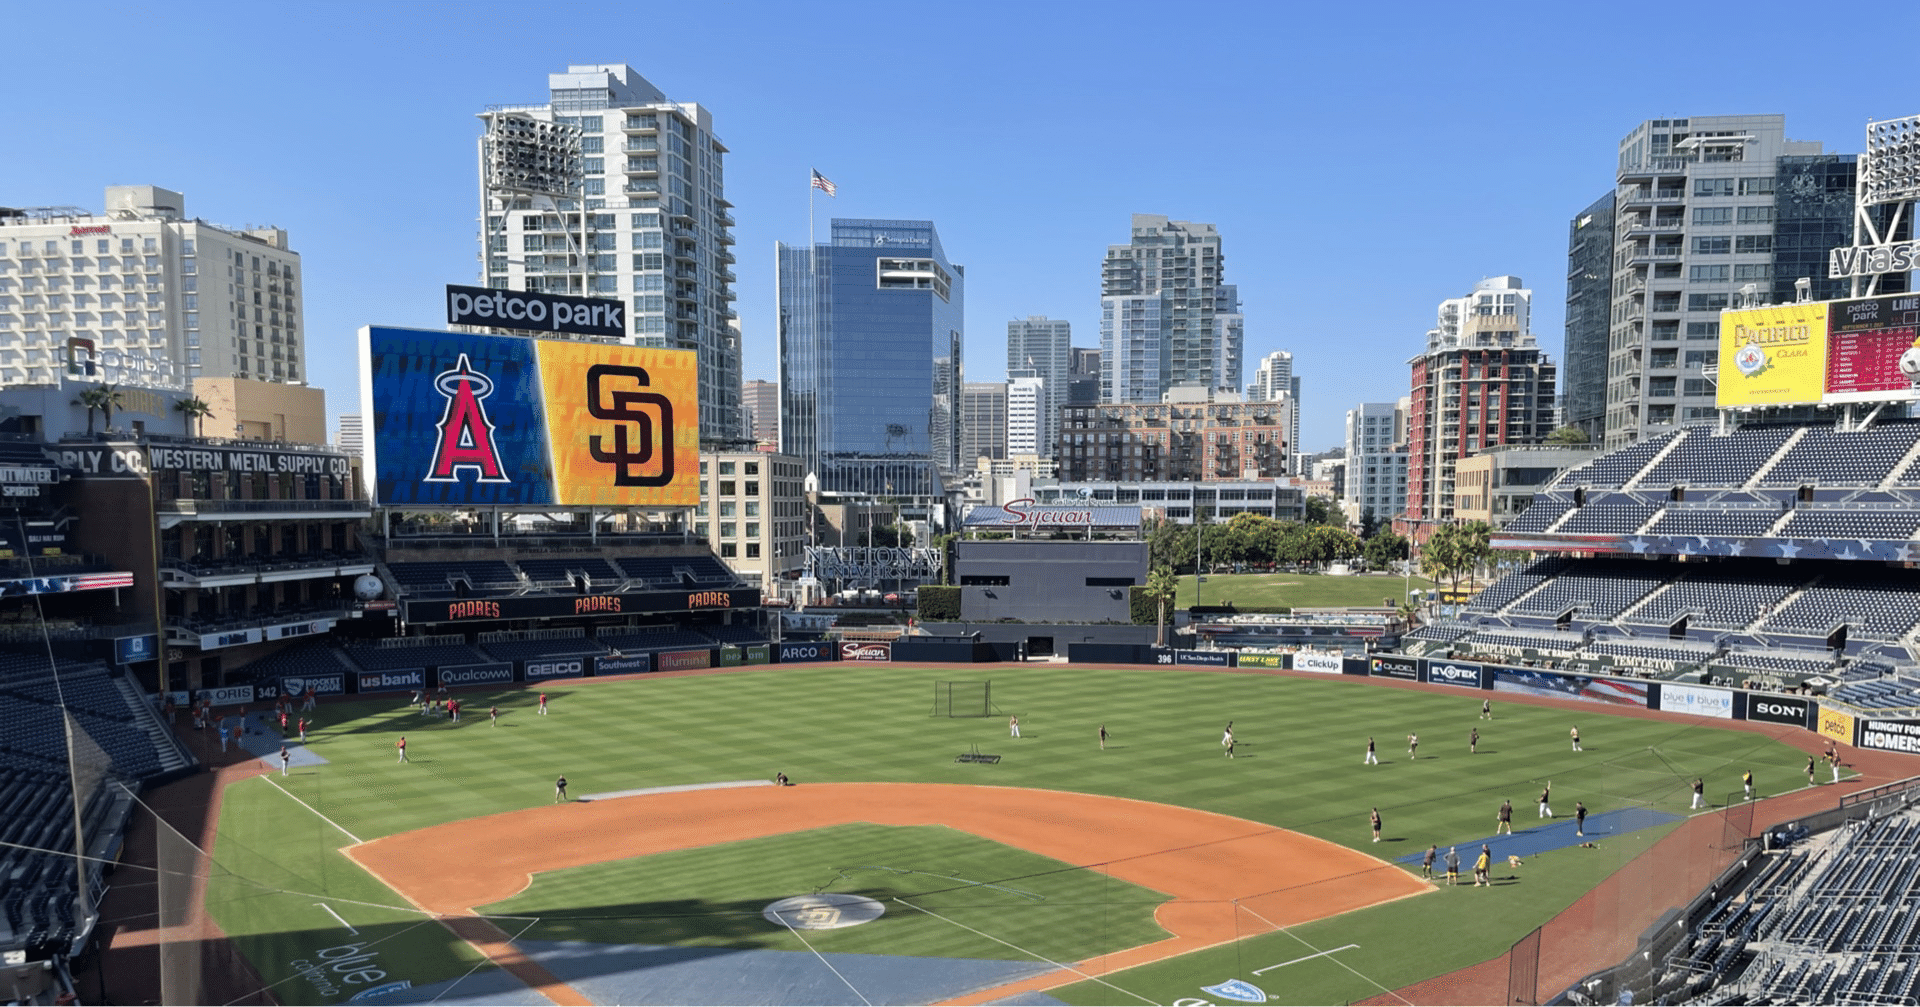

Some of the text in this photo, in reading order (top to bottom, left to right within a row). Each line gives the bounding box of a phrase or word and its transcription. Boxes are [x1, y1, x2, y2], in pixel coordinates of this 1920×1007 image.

[450, 291, 623, 330] petco park
[1847, 303, 1879, 315] petco
[1892, 298, 1919, 311] LINE
[1852, 311, 1878, 323] park
[111, 450, 148, 473] CO.
[150, 448, 350, 474] WESTERN METAL SUPPLY CO.
[3, 486, 40, 497] SPIRITS
[1052, 498, 1117, 507] Gallagher Square
[1001, 498, 1096, 531] Sycuan
[815, 564, 941, 579] UNIVERSITY
[575, 596, 621, 614] PADRES
[688, 591, 730, 609] PADRES
[449, 600, 501, 620] PADRES
[782, 647, 818, 659] ARCO
[842, 643, 885, 660] Sycuan
[1471, 643, 1523, 657] TEMPLETON
[598, 660, 641, 670] Southwest
[662, 657, 707, 668] illumina
[1157, 654, 1172, 664] 396
[1307, 659, 1339, 670] ClickUp
[1612, 654, 1675, 672] TEMPLETON
[441, 669, 510, 683] Qualcomm
[527, 662, 582, 676] GEICO
[1431, 665, 1478, 679] EVOTEK
[216, 687, 251, 700] ORIS
[258, 687, 277, 698] 342
[1663, 692, 1684, 702] blue
[1697, 695, 1719, 705] blue
[1756, 702, 1805, 718] SONY
[1825, 720, 1845, 735] petco
[1868, 720, 1920, 736] HUNGRY FOR
[316, 941, 387, 985] blue
